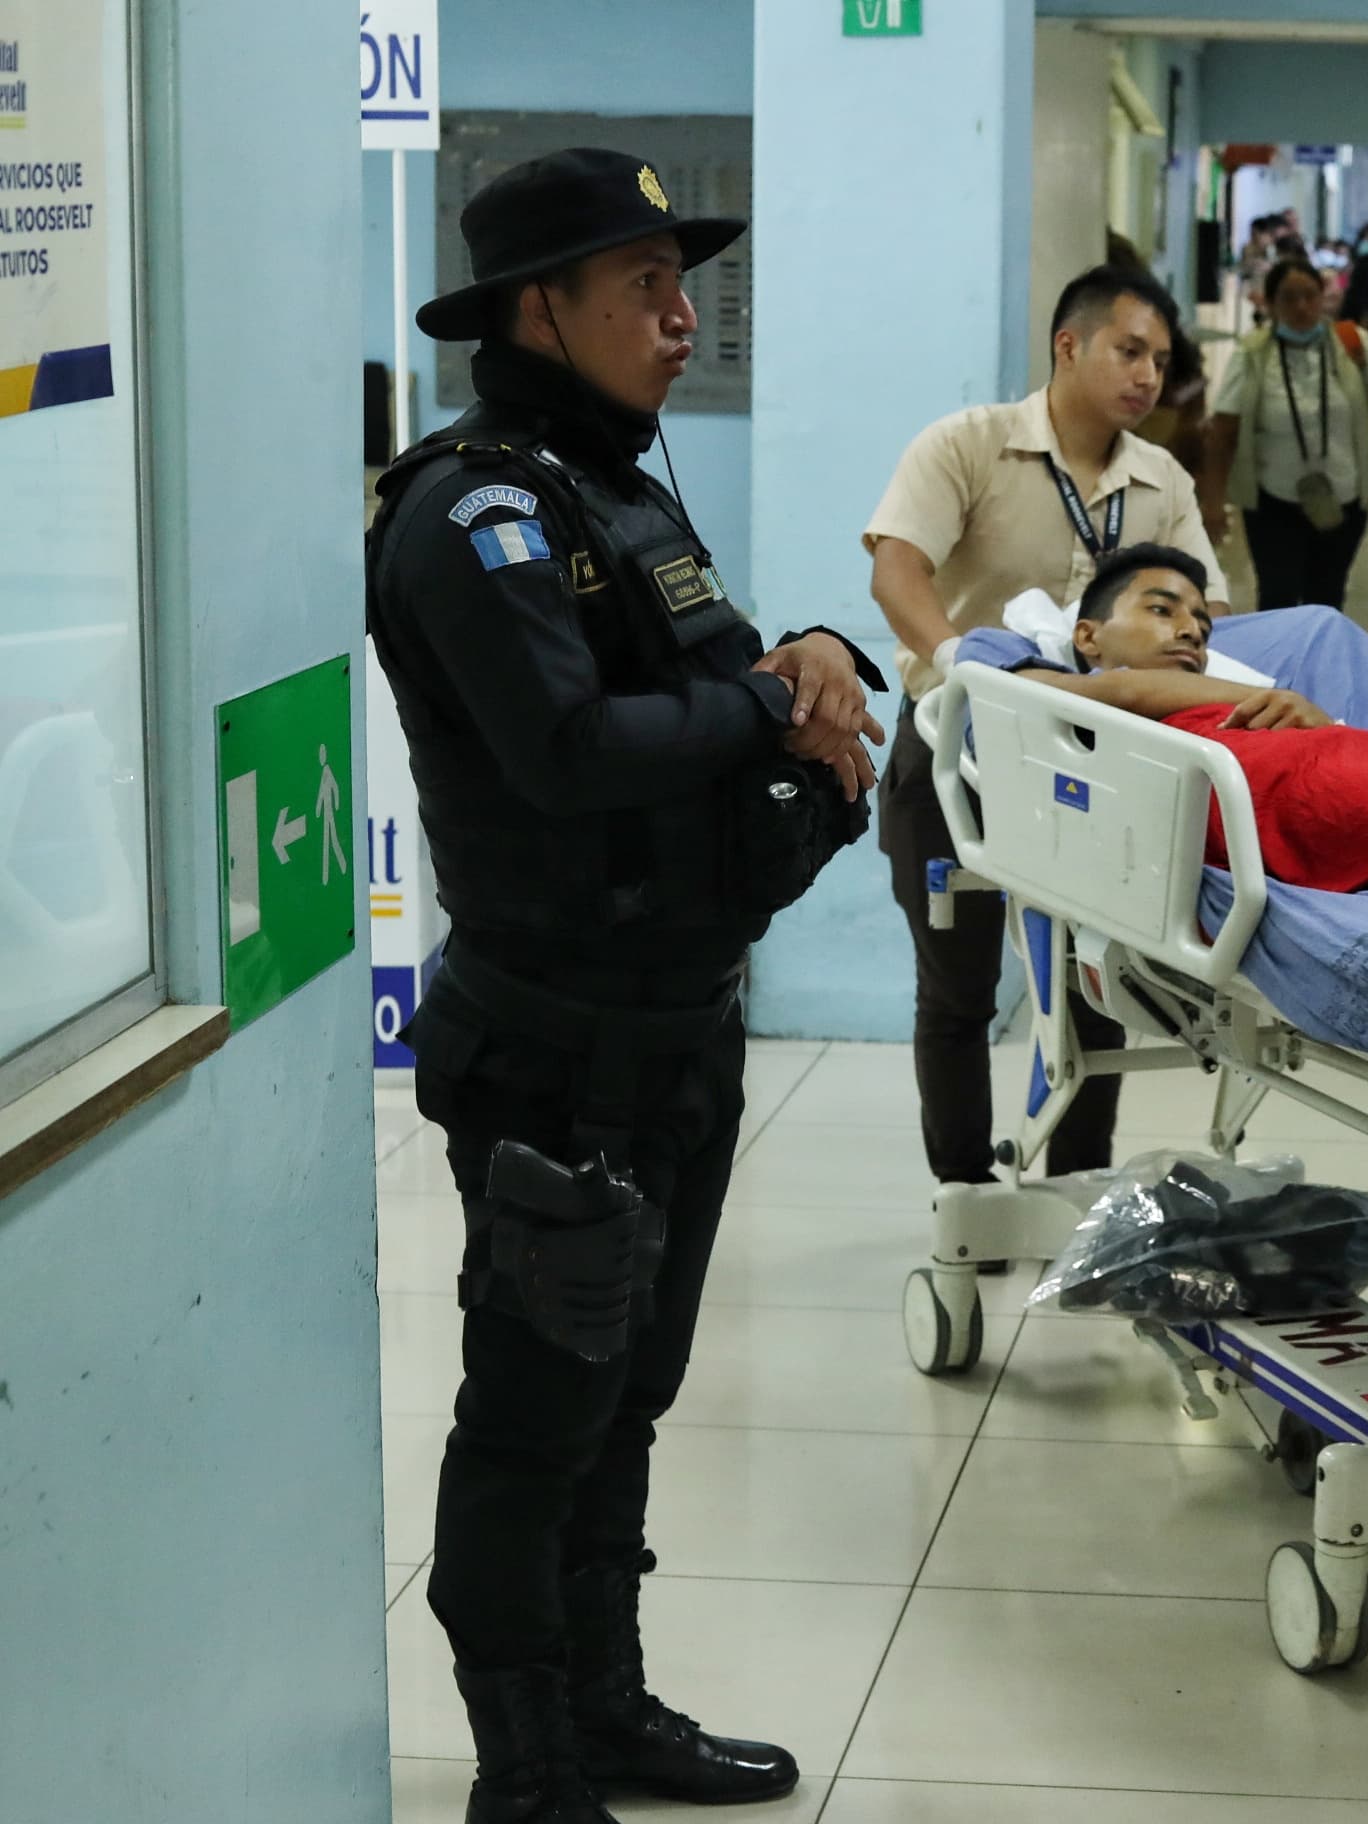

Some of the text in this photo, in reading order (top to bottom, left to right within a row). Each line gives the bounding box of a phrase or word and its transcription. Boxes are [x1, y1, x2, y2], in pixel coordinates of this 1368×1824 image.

[56, 162, 82, 192] QUE
[15, 204, 93, 232] ROOSEVELT
[0, 248, 48, 278] TUITOS
[457, 489, 529, 519] GUATEMALA
